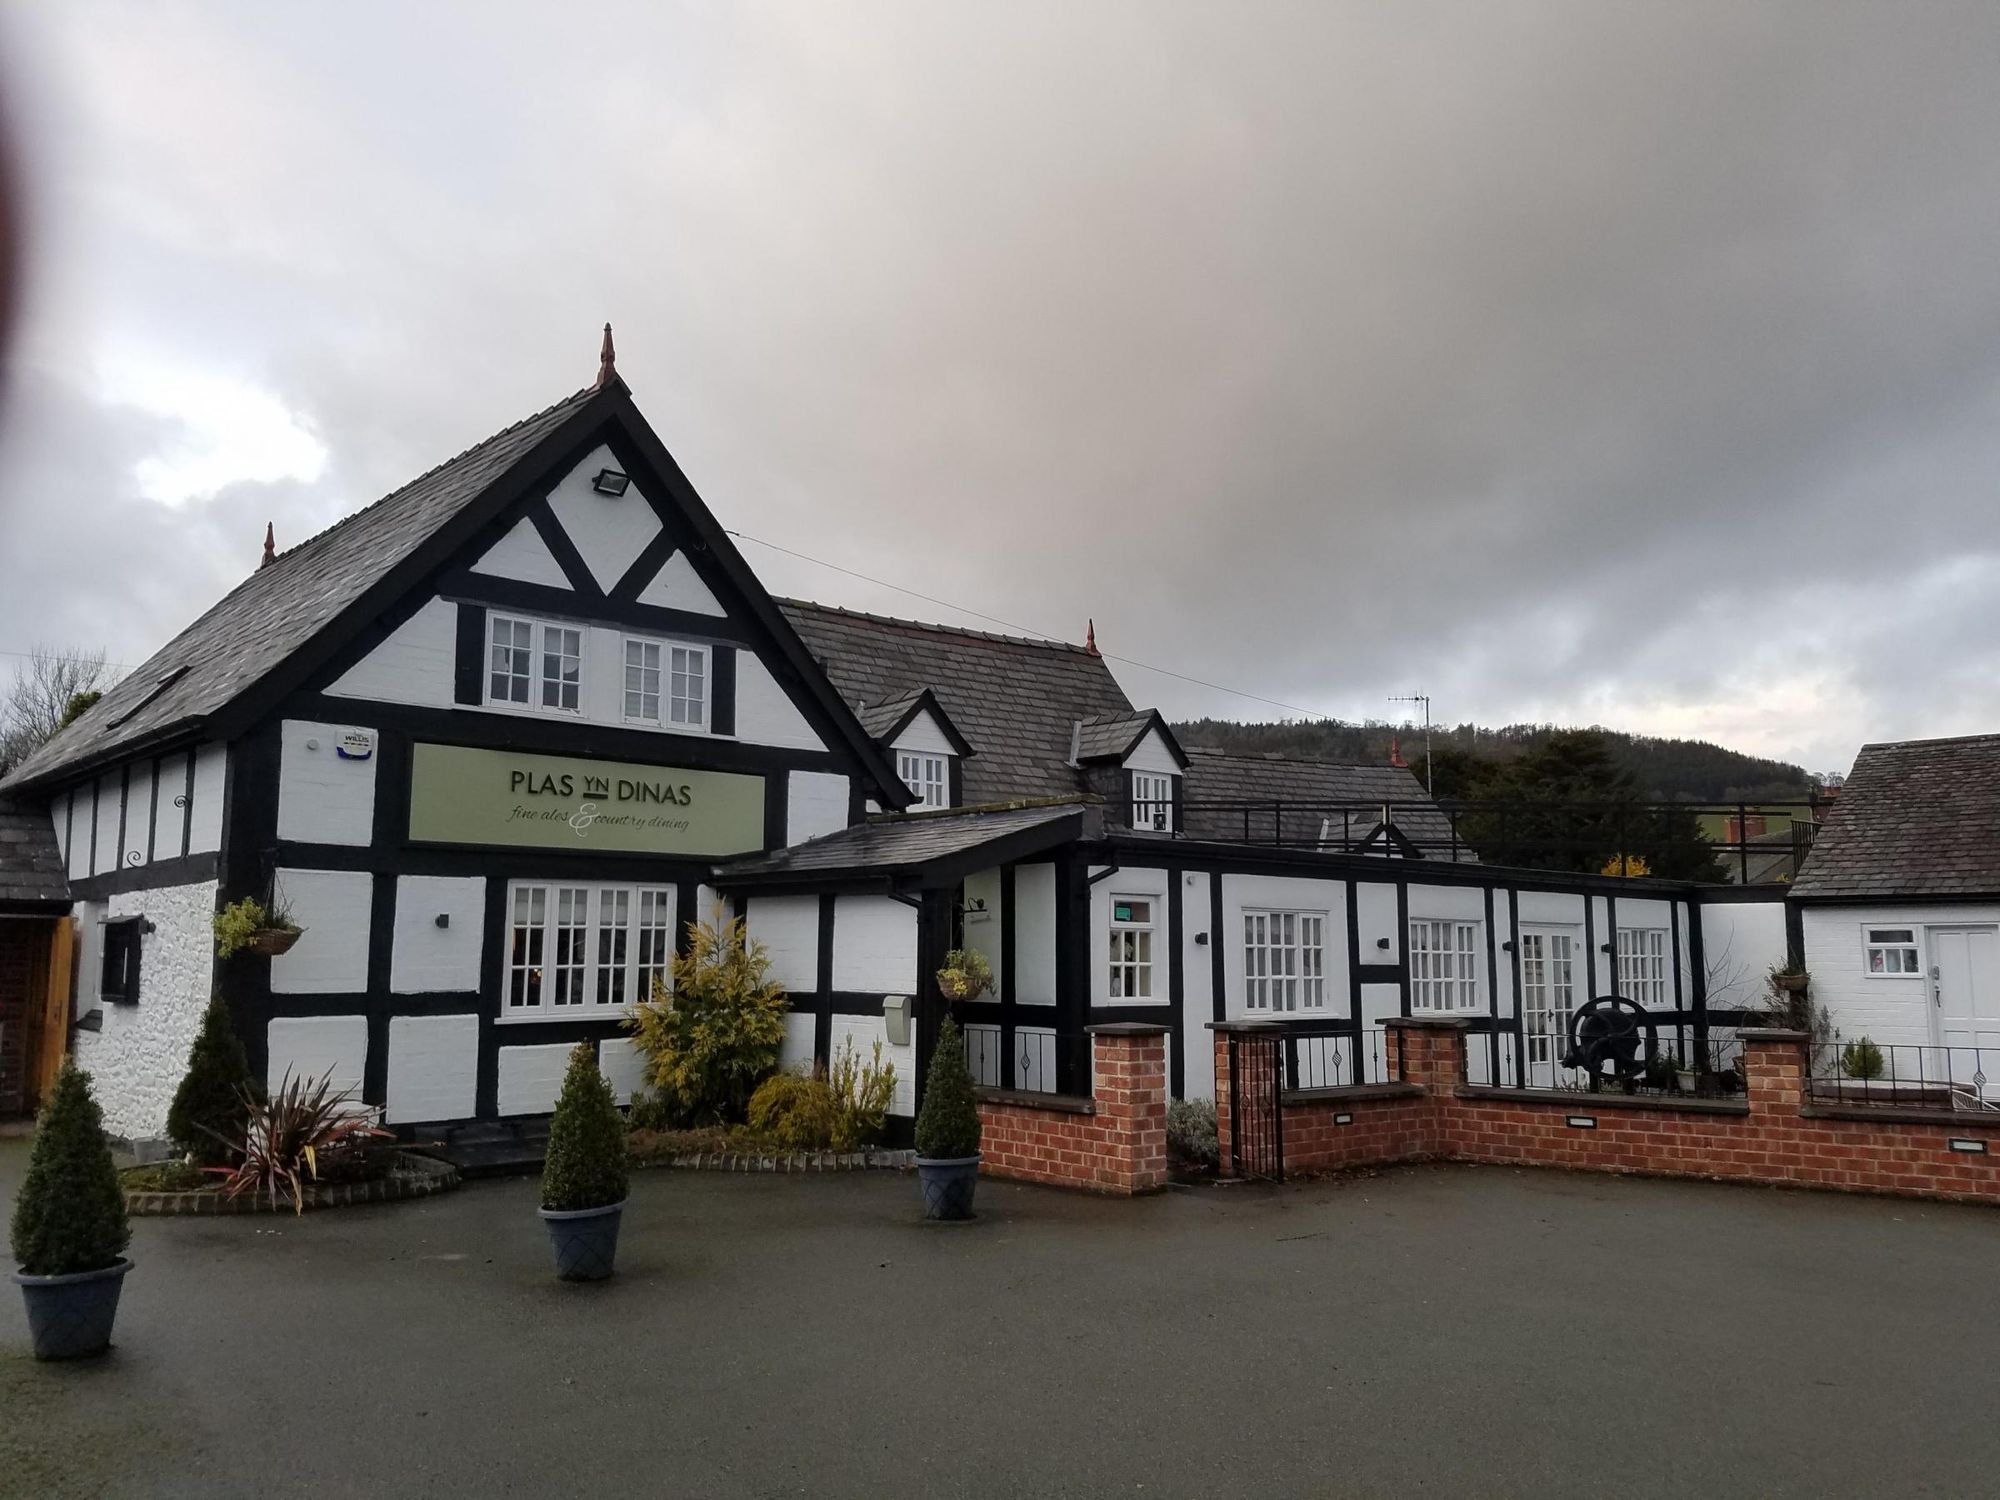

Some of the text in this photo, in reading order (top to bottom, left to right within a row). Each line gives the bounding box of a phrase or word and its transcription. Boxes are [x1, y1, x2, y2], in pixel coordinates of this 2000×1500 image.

[511, 770, 692, 806] PLAS YN DINAS
[506, 803, 690, 837] fine ales & country dining
